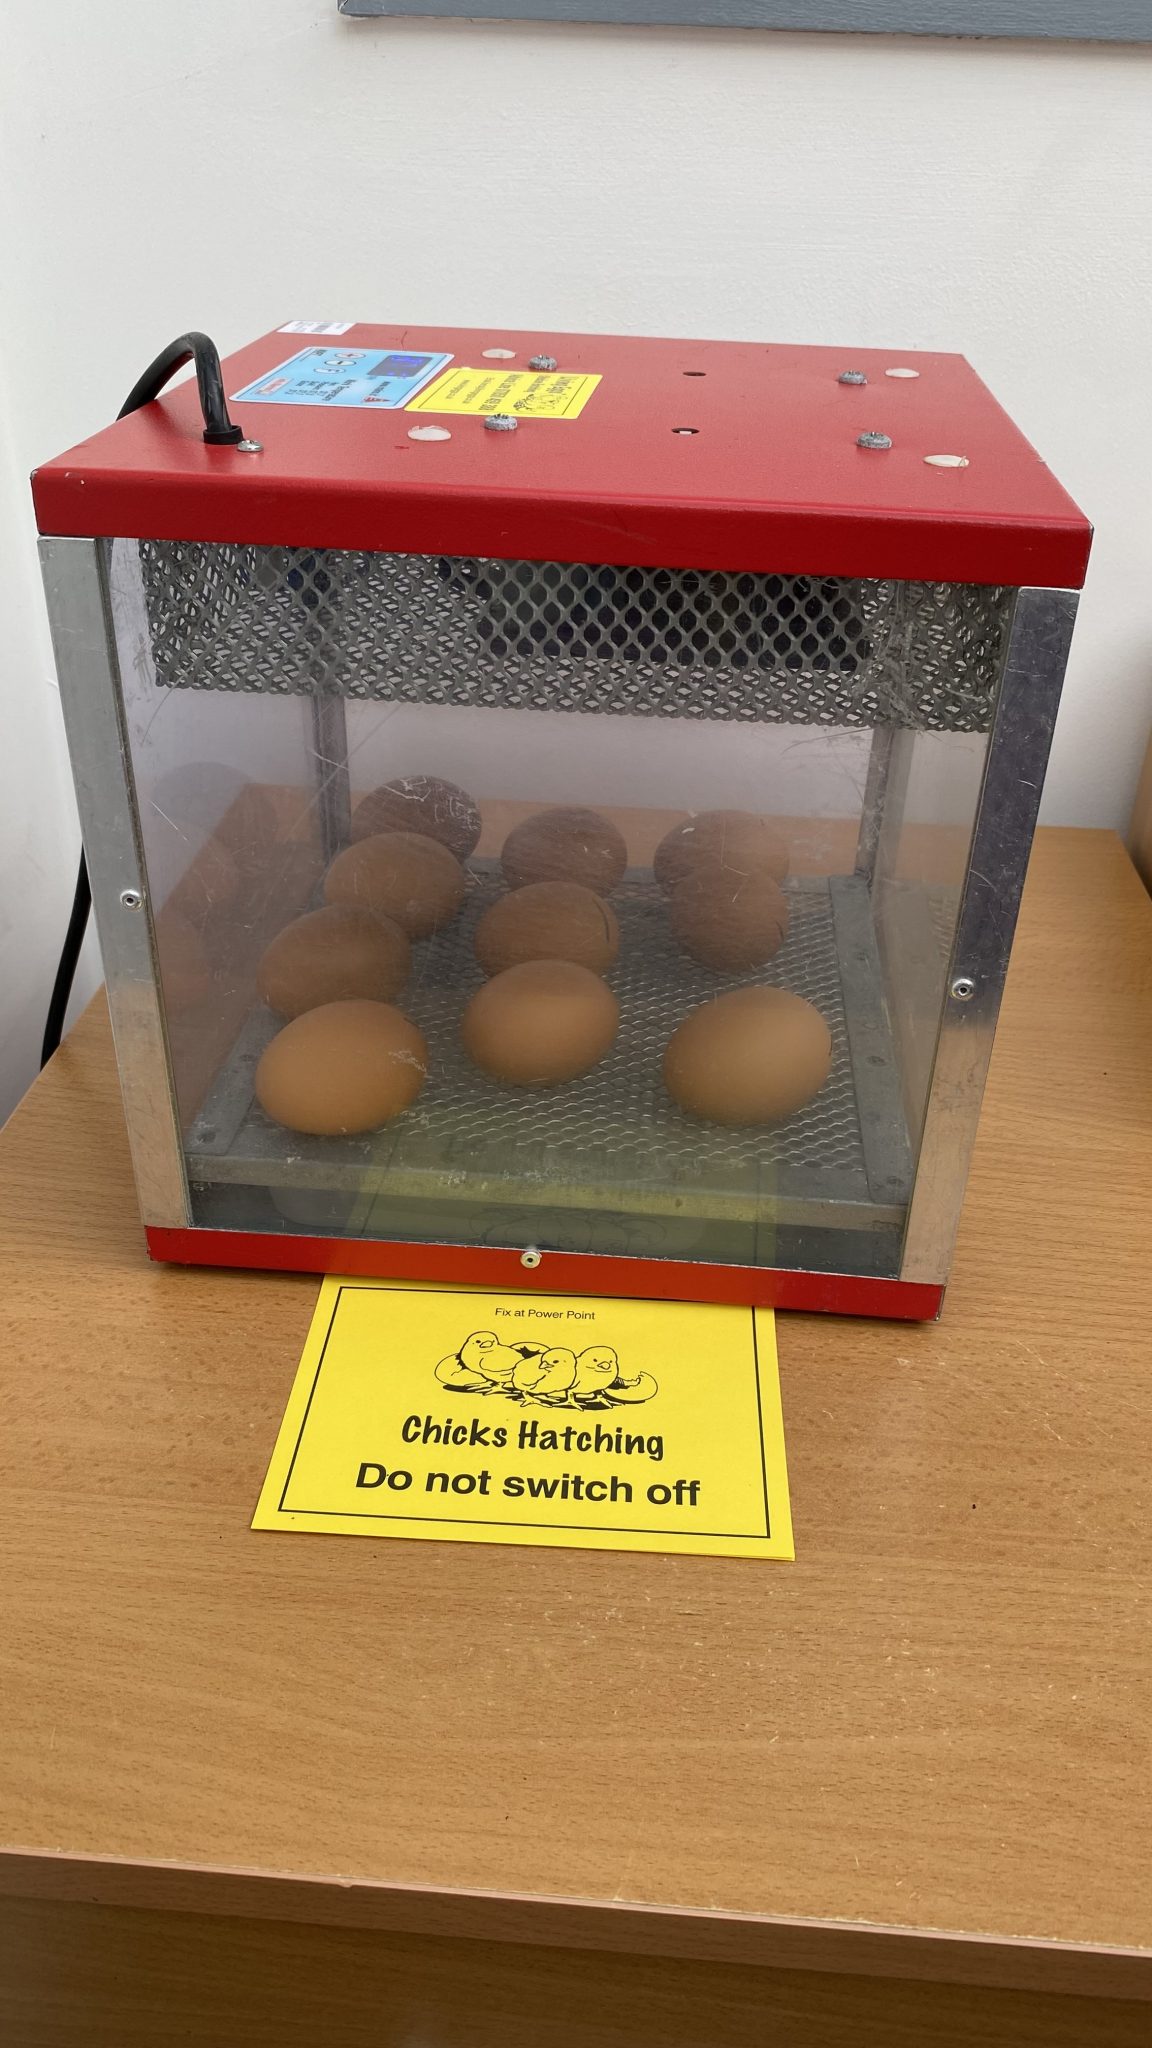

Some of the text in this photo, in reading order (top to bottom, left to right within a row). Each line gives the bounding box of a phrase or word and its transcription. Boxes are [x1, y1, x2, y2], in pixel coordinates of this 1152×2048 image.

[494, 1307, 595, 1320] Fix at Power Point
[401, 1414, 664, 1462] Chicks Hatching
[355, 1462, 701, 1507] Do not switch off
